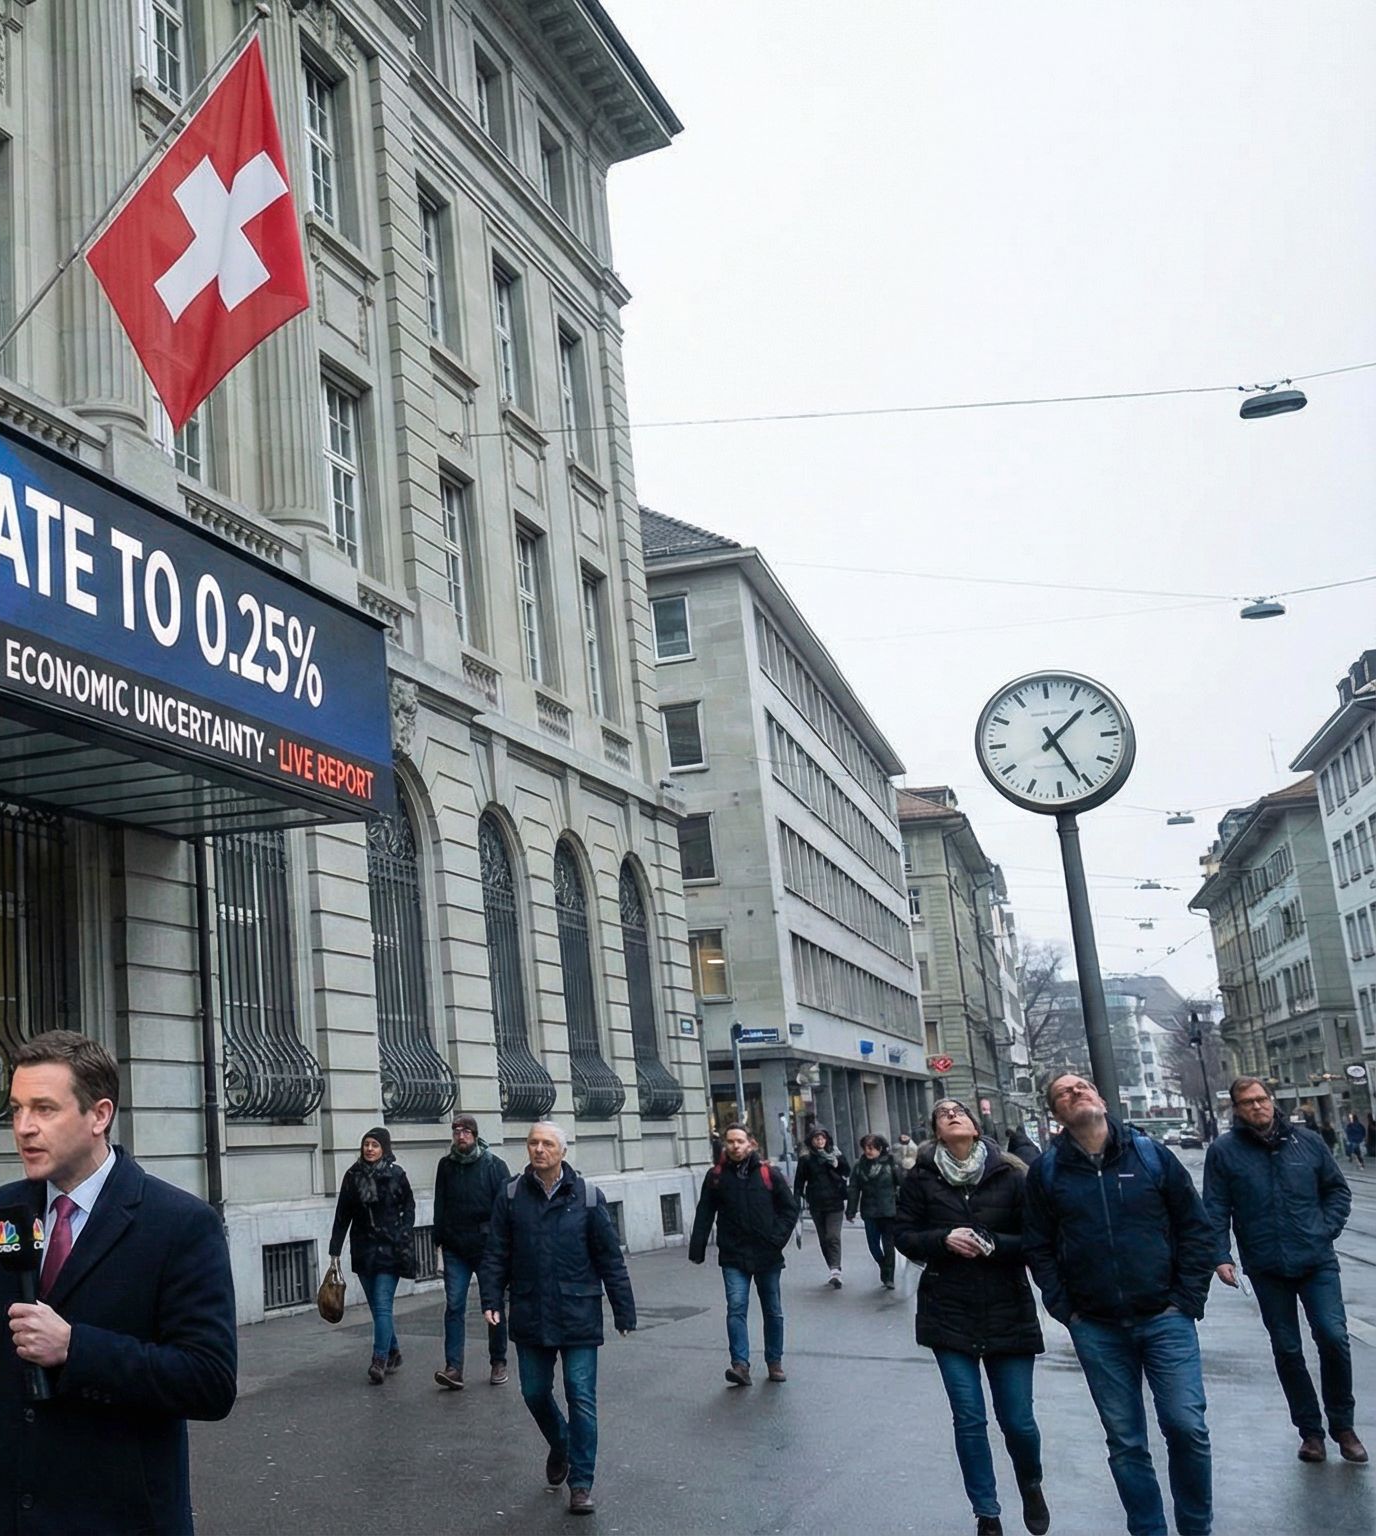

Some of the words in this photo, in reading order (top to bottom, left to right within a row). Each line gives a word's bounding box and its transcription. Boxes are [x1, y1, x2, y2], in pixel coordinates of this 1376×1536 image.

[111, 526, 182, 648] TO
[195, 573, 323, 708] 0.25%
[5, 638, 130, 717] ECONOMIC
[134, 685, 265, 763] UNCERTAINTY
[279, 738, 314, 781] LIVE
[317, 752, 374, 800] REPORT
